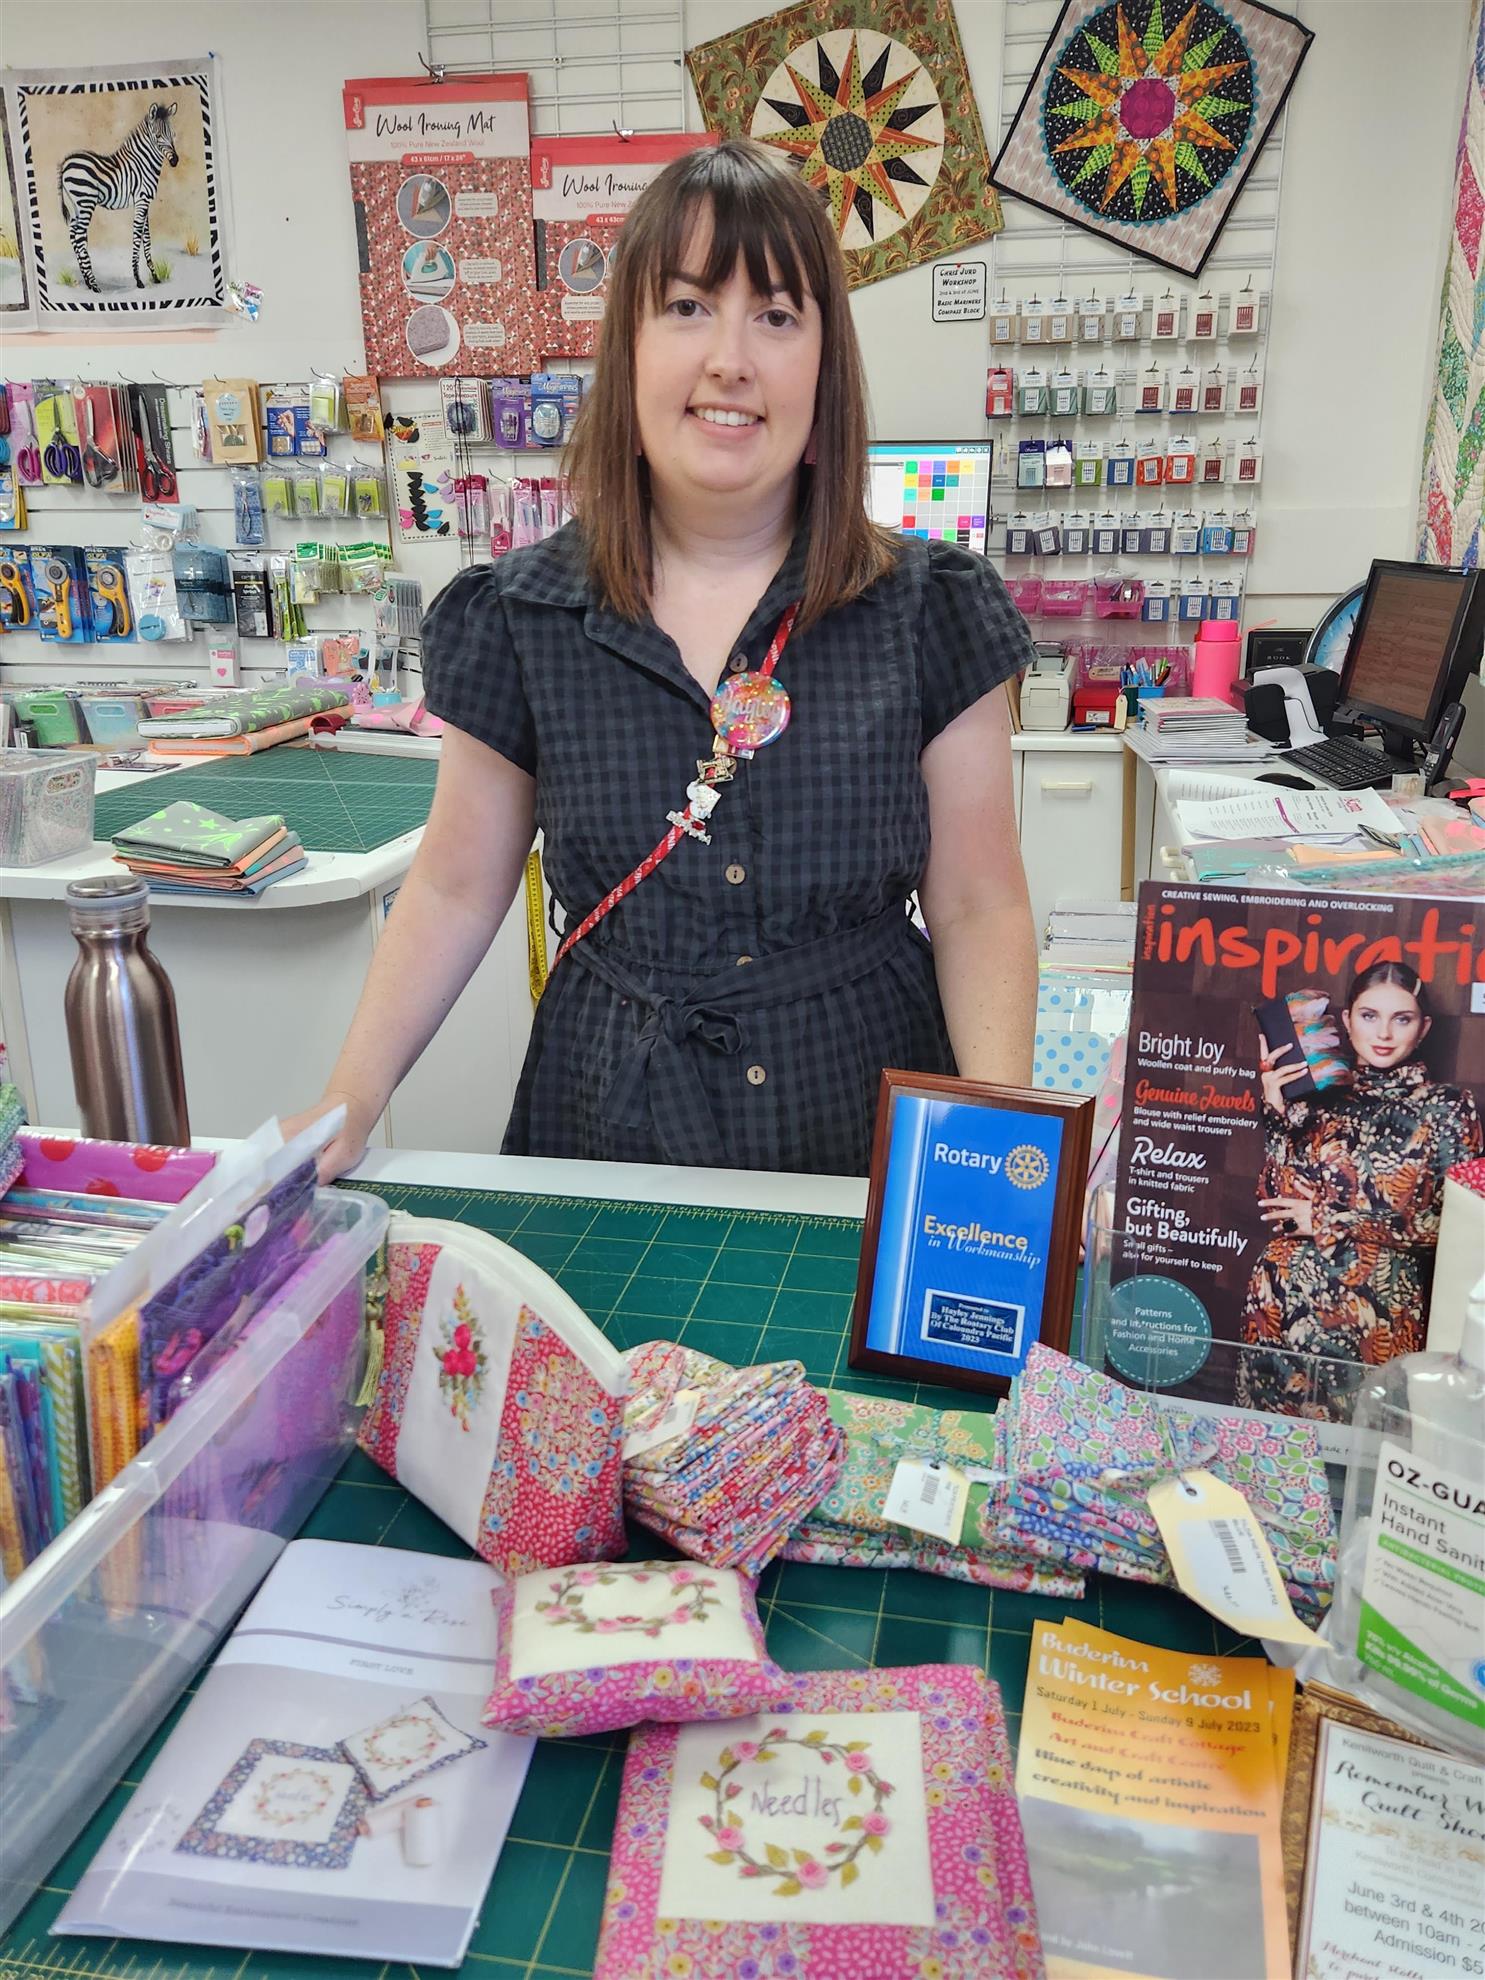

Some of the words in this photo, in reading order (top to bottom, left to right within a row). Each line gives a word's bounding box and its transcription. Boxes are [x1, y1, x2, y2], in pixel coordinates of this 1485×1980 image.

[376, 113, 413, 137] Wool
[417, 112, 461, 138] Ironing
[466, 111, 496, 134] Mat
[425, 140, 440, 148] New
[563, 173, 599, 197] Wool
[942, 278, 977, 286] WORKSHOP
[1161, 889, 1201, 901] CREATIVE
[1203, 892, 1239, 904] SEWING,
[1240, 895, 1307, 907] EMBROIDERING
[1308, 899, 1328, 909] AND
[1330, 901, 1394, 913] OVERLOCKING
[1158, 903, 1485, 999] inspirati
[1138, 1031, 1192, 1060] Bright
[1195, 1037, 1225, 1065] Joy
[1137, 1058, 1173, 1070] Woollen
[1174, 1063, 1193, 1072] coat
[1194, 1064, 1212, 1074] and
[1213, 1065, 1238, 1078] puffy
[1239, 1067, 1256, 1079] bag
[1135, 1079, 1198, 1106] Genuine
[1200, 1084, 1255, 1112] Jewels
[1133, 1106, 1162, 1116] Blouse
[1163, 1110, 1182, 1119] with
[1184, 1113, 1207, 1122] relief
[1208, 1115, 1258, 1129] embroidery
[1133, 1117, 1149, 1126] and
[1150, 1119, 1172, 1129] wide
[1173, 1122, 1196, 1132] waist
[1197, 1125, 1232, 1136] trousers
[934, 1142, 1003, 1175] Rotary
[1130, 1136, 1206, 1170] Relax
[1128, 1176, 1137, 1184] in
[1138, 1178, 1169, 1190] knitted
[1170, 1181, 1195, 1193] fabric
[1129, 1166, 1155, 1177] T-shirt
[1156, 1170, 1173, 1180] and
[1175, 1172, 1209, 1184] trousers
[1126, 1197, 1191, 1229] Gifting,
[923, 1214, 1028, 1250] Excellence
[1125, 1216, 1152, 1237] but
[1157, 1221, 1248, 1256] Beautifully
[928, 1235, 941, 1248] in
[946, 1231, 1041, 1270] Workmanship
[1141, 1252, 1153, 1261] for
[1154, 1255, 1188, 1267] yourself
[1190, 1260, 1200, 1268] to
[1201, 1260, 1223, 1272] keep
[1147, 1242, 1166, 1254] gifts
[941, 1306, 969, 1318] Hayley
[943, 1314, 959, 1324] The
[994, 1324, 1014, 1334] Club
[1111, 1317, 1128, 1326] and
[1183, 1323, 1198, 1333] for
[1134, 1307, 1173, 1319] Patterns
[1112, 1328, 1146, 1340] Fashion
[1128, 1343, 1179, 1357] Accessories
[1383, 1492, 1447, 1535] Instant
[1381, 1511, 1430, 1546] Hand
[1042, 1631, 1149, 1673] Buderim
[1040, 1654, 1140, 1696] Winter
[1148, 1681, 1251, 1710] School
[1036, 1686, 1089, 1709] Saturday
[1092, 1700, 1097, 1711] 1
[1101, 1704, 1126, 1718] July
[1138, 1710, 1181, 1728] Sunday
[1198, 1719, 1223, 1732] July
[1227, 1720, 1260, 1733] 2023
[1032, 1771, 1120, 1806] creativity
[1125, 1769, 1144, 1781] of
[1335, 1760, 1450, 1812] Remember
[1440, 1766, 1449, 1776] &
[1453, 1769, 1483, 1785] Craft
[751, 1775, 843, 1827] Needles
[1361, 1791, 1421, 1820] Quilt
[1347, 1881, 1385, 1903] June
[1390, 1893, 1416, 1913] 3rd
[1421, 1904, 1433, 1918] &
[1439, 1910, 1464, 1928] 4th
[1344, 1899, 1410, 1931] between
[1418, 1922, 1460, 1947] 10am
[1374, 1929, 1456, 1967] Admission
[1461, 1956, 1484, 1976] $5
